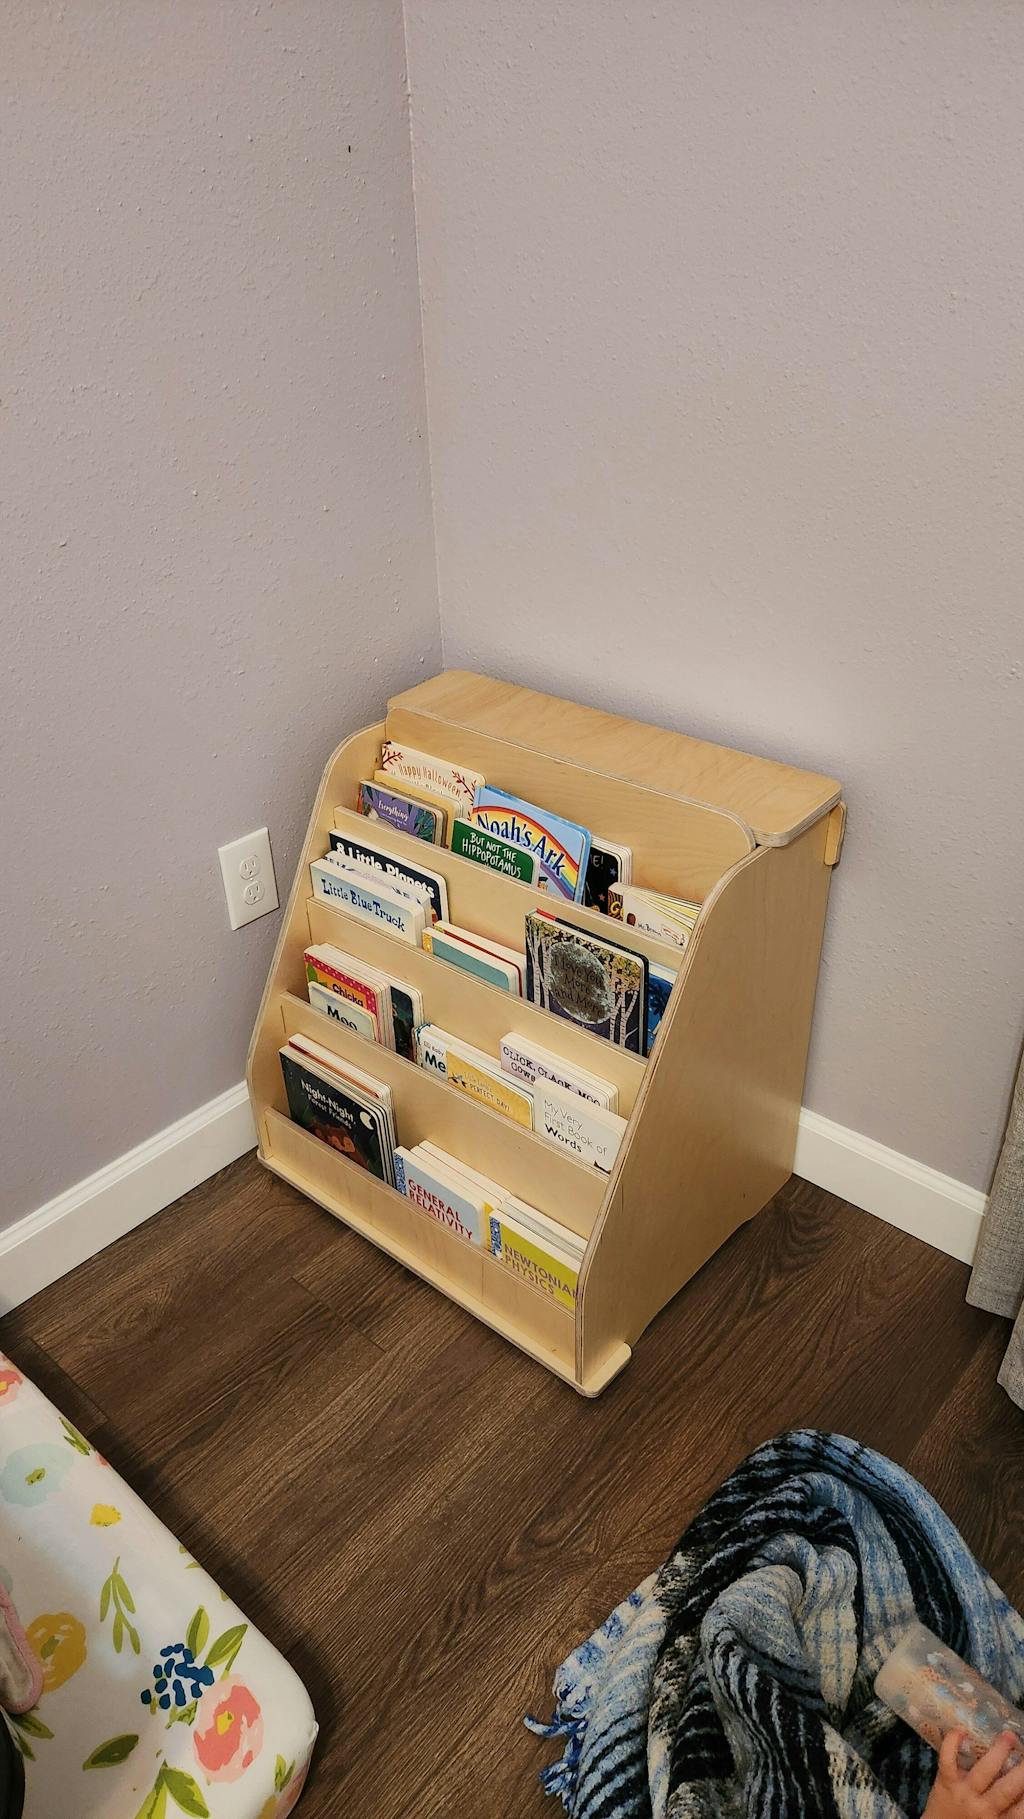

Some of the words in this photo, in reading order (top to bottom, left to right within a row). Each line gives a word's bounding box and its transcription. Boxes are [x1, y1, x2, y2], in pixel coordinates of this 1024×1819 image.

[462, 838, 522, 878] HIPPOPOTAMUS
[470, 832, 485, 845] BUT
[486, 840, 502, 854] NOT
[502, 847, 517, 863] THE
[477, 813, 533, 848] Noah's
[532, 835, 565, 876] Ark
[349, 847, 382, 870] Little
[386, 863, 434, 898] Planets
[321, 878, 348, 900] Little
[350, 889, 373, 912] Blue
[372, 900, 405, 932] Truck
[425, 1050, 446, 1073] Me
[503, 1046, 536, 1072] CLICK,
[545, 1123, 582, 1153] Words
[560, 1108, 583, 1131] Very
[568, 1125, 594, 1149] Book
[596, 1145, 608, 1156] of
[408, 1178, 461, 1223] GENERAL
[409, 1188, 473, 1240] RELATIVITY
[505, 1254, 554, 1295] PHYSICS
